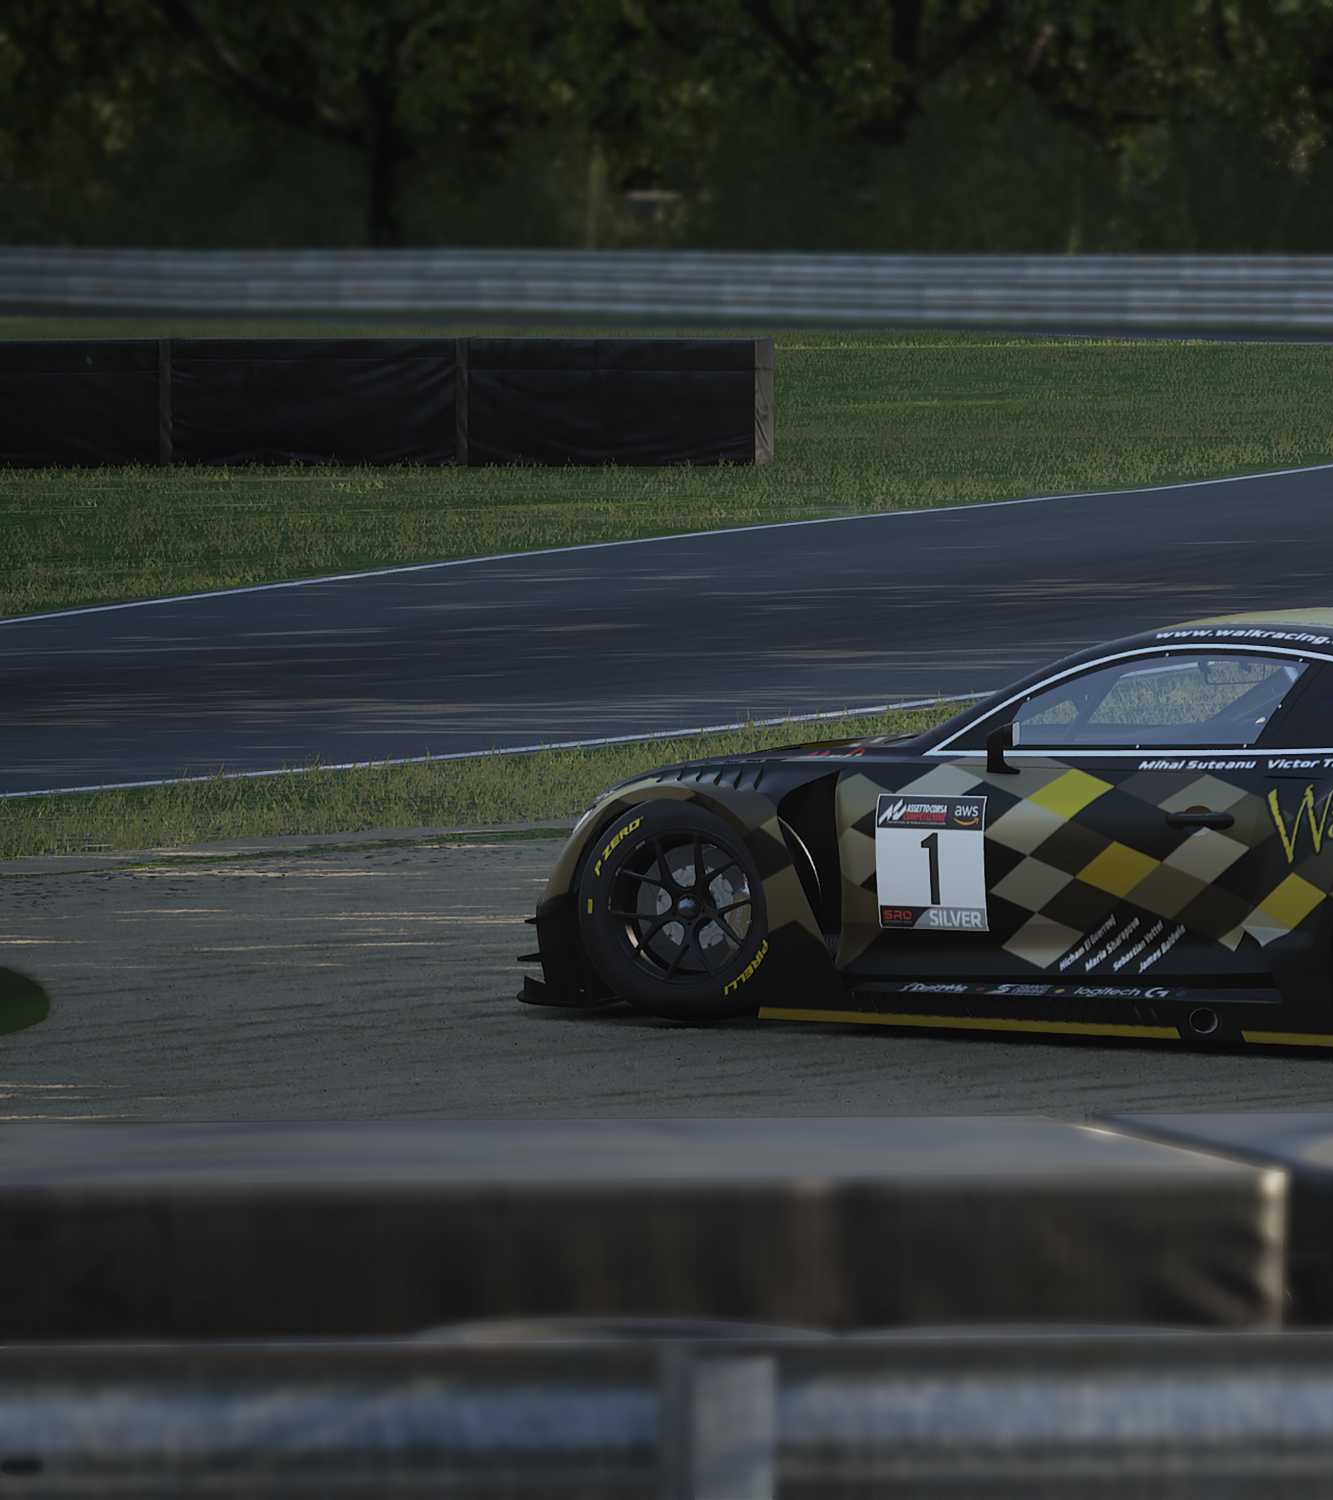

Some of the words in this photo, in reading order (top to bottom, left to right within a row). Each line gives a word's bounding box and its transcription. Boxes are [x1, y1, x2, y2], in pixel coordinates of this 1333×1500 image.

[1185, 760, 1257, 771] Suteanu
[1267, 758, 1316, 770] Victor
[954, 804, 980, 817] aws
[592, 858, 603, 878] P
[602, 816, 643, 862] ZERO
[921, 832, 941, 905] 1
[929, 909, 985, 928] SILVER
[721, 938, 770, 996] PIRELLI
[1073, 985, 1144, 999] logitech
